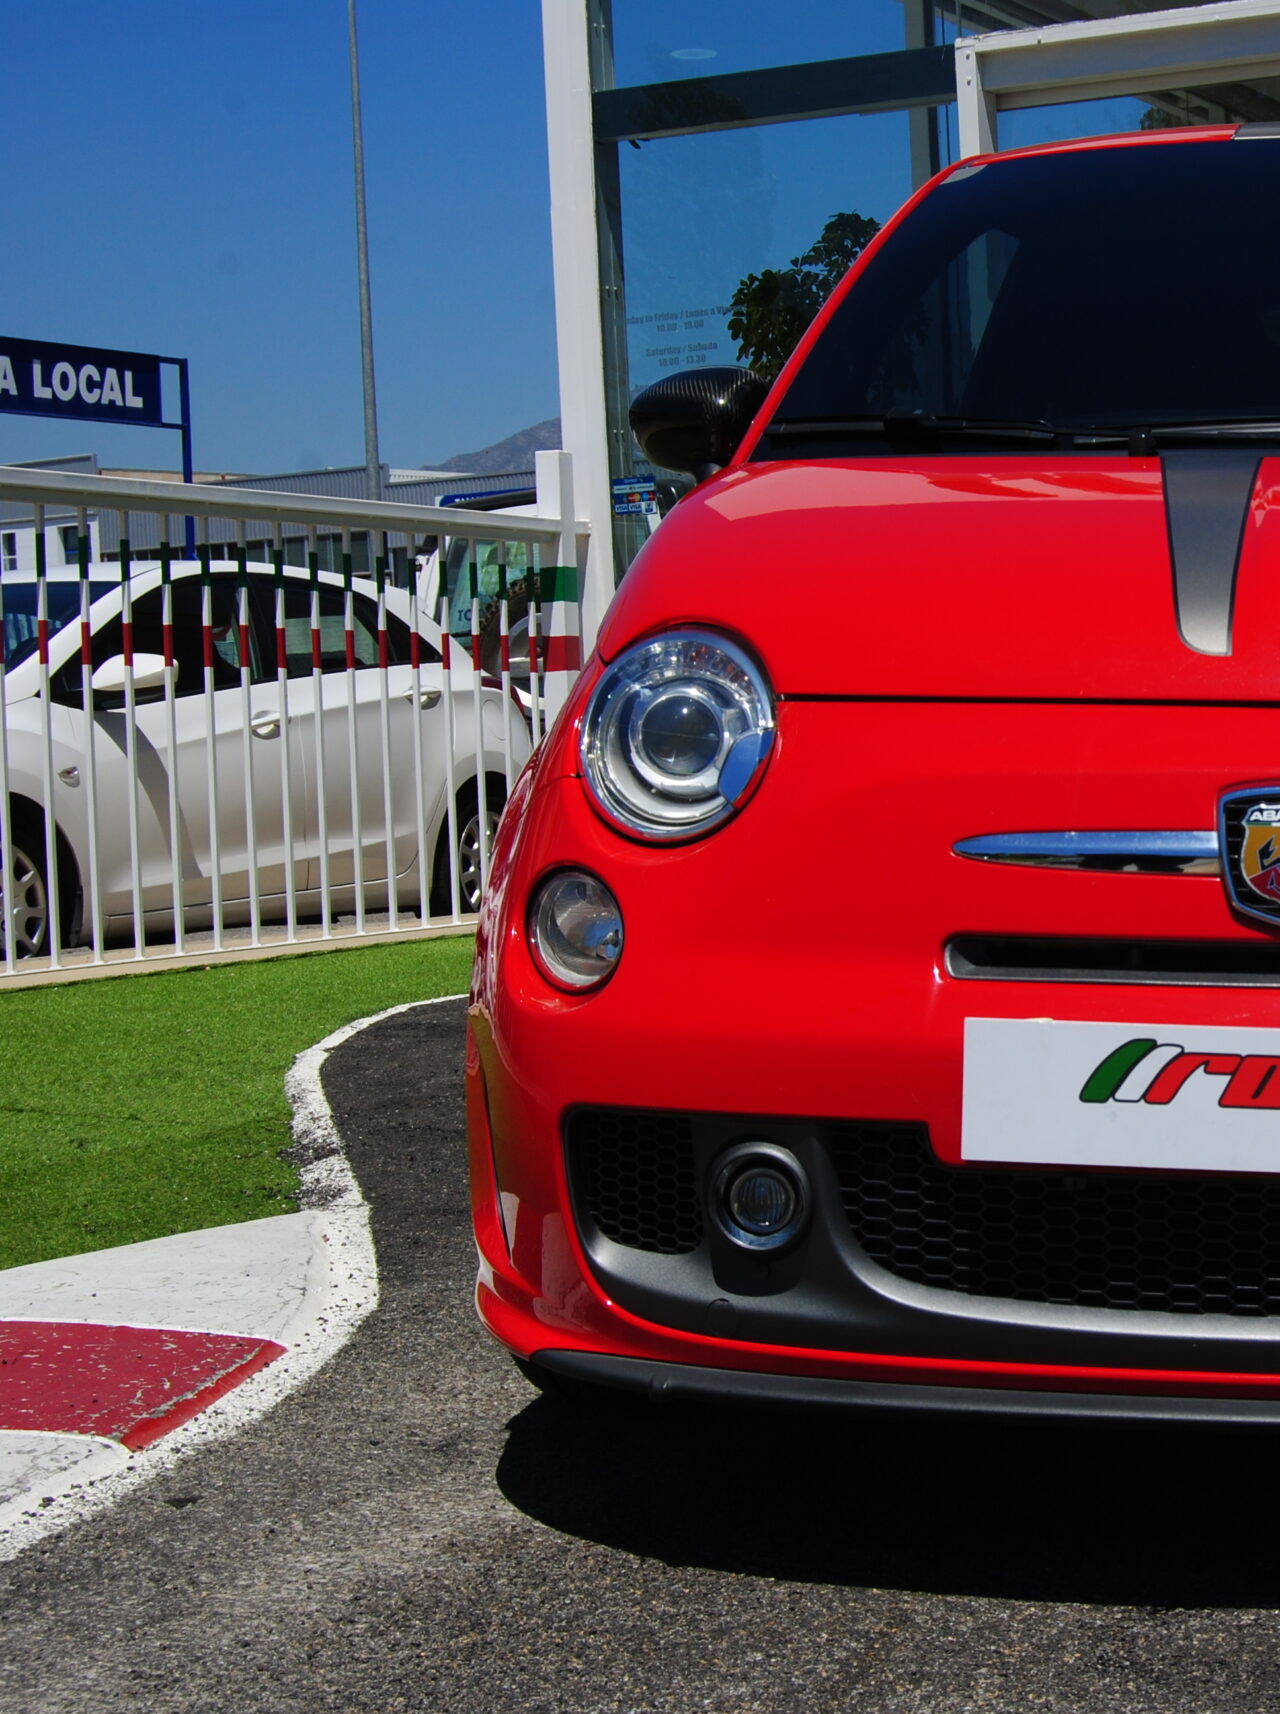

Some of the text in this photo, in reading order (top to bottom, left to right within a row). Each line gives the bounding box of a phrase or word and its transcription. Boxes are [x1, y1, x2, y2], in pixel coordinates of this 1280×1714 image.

[654, 311, 679, 322] Friday
[646, 345, 681, 357] Saturday
[32, 359, 144, 408] LOCAL
